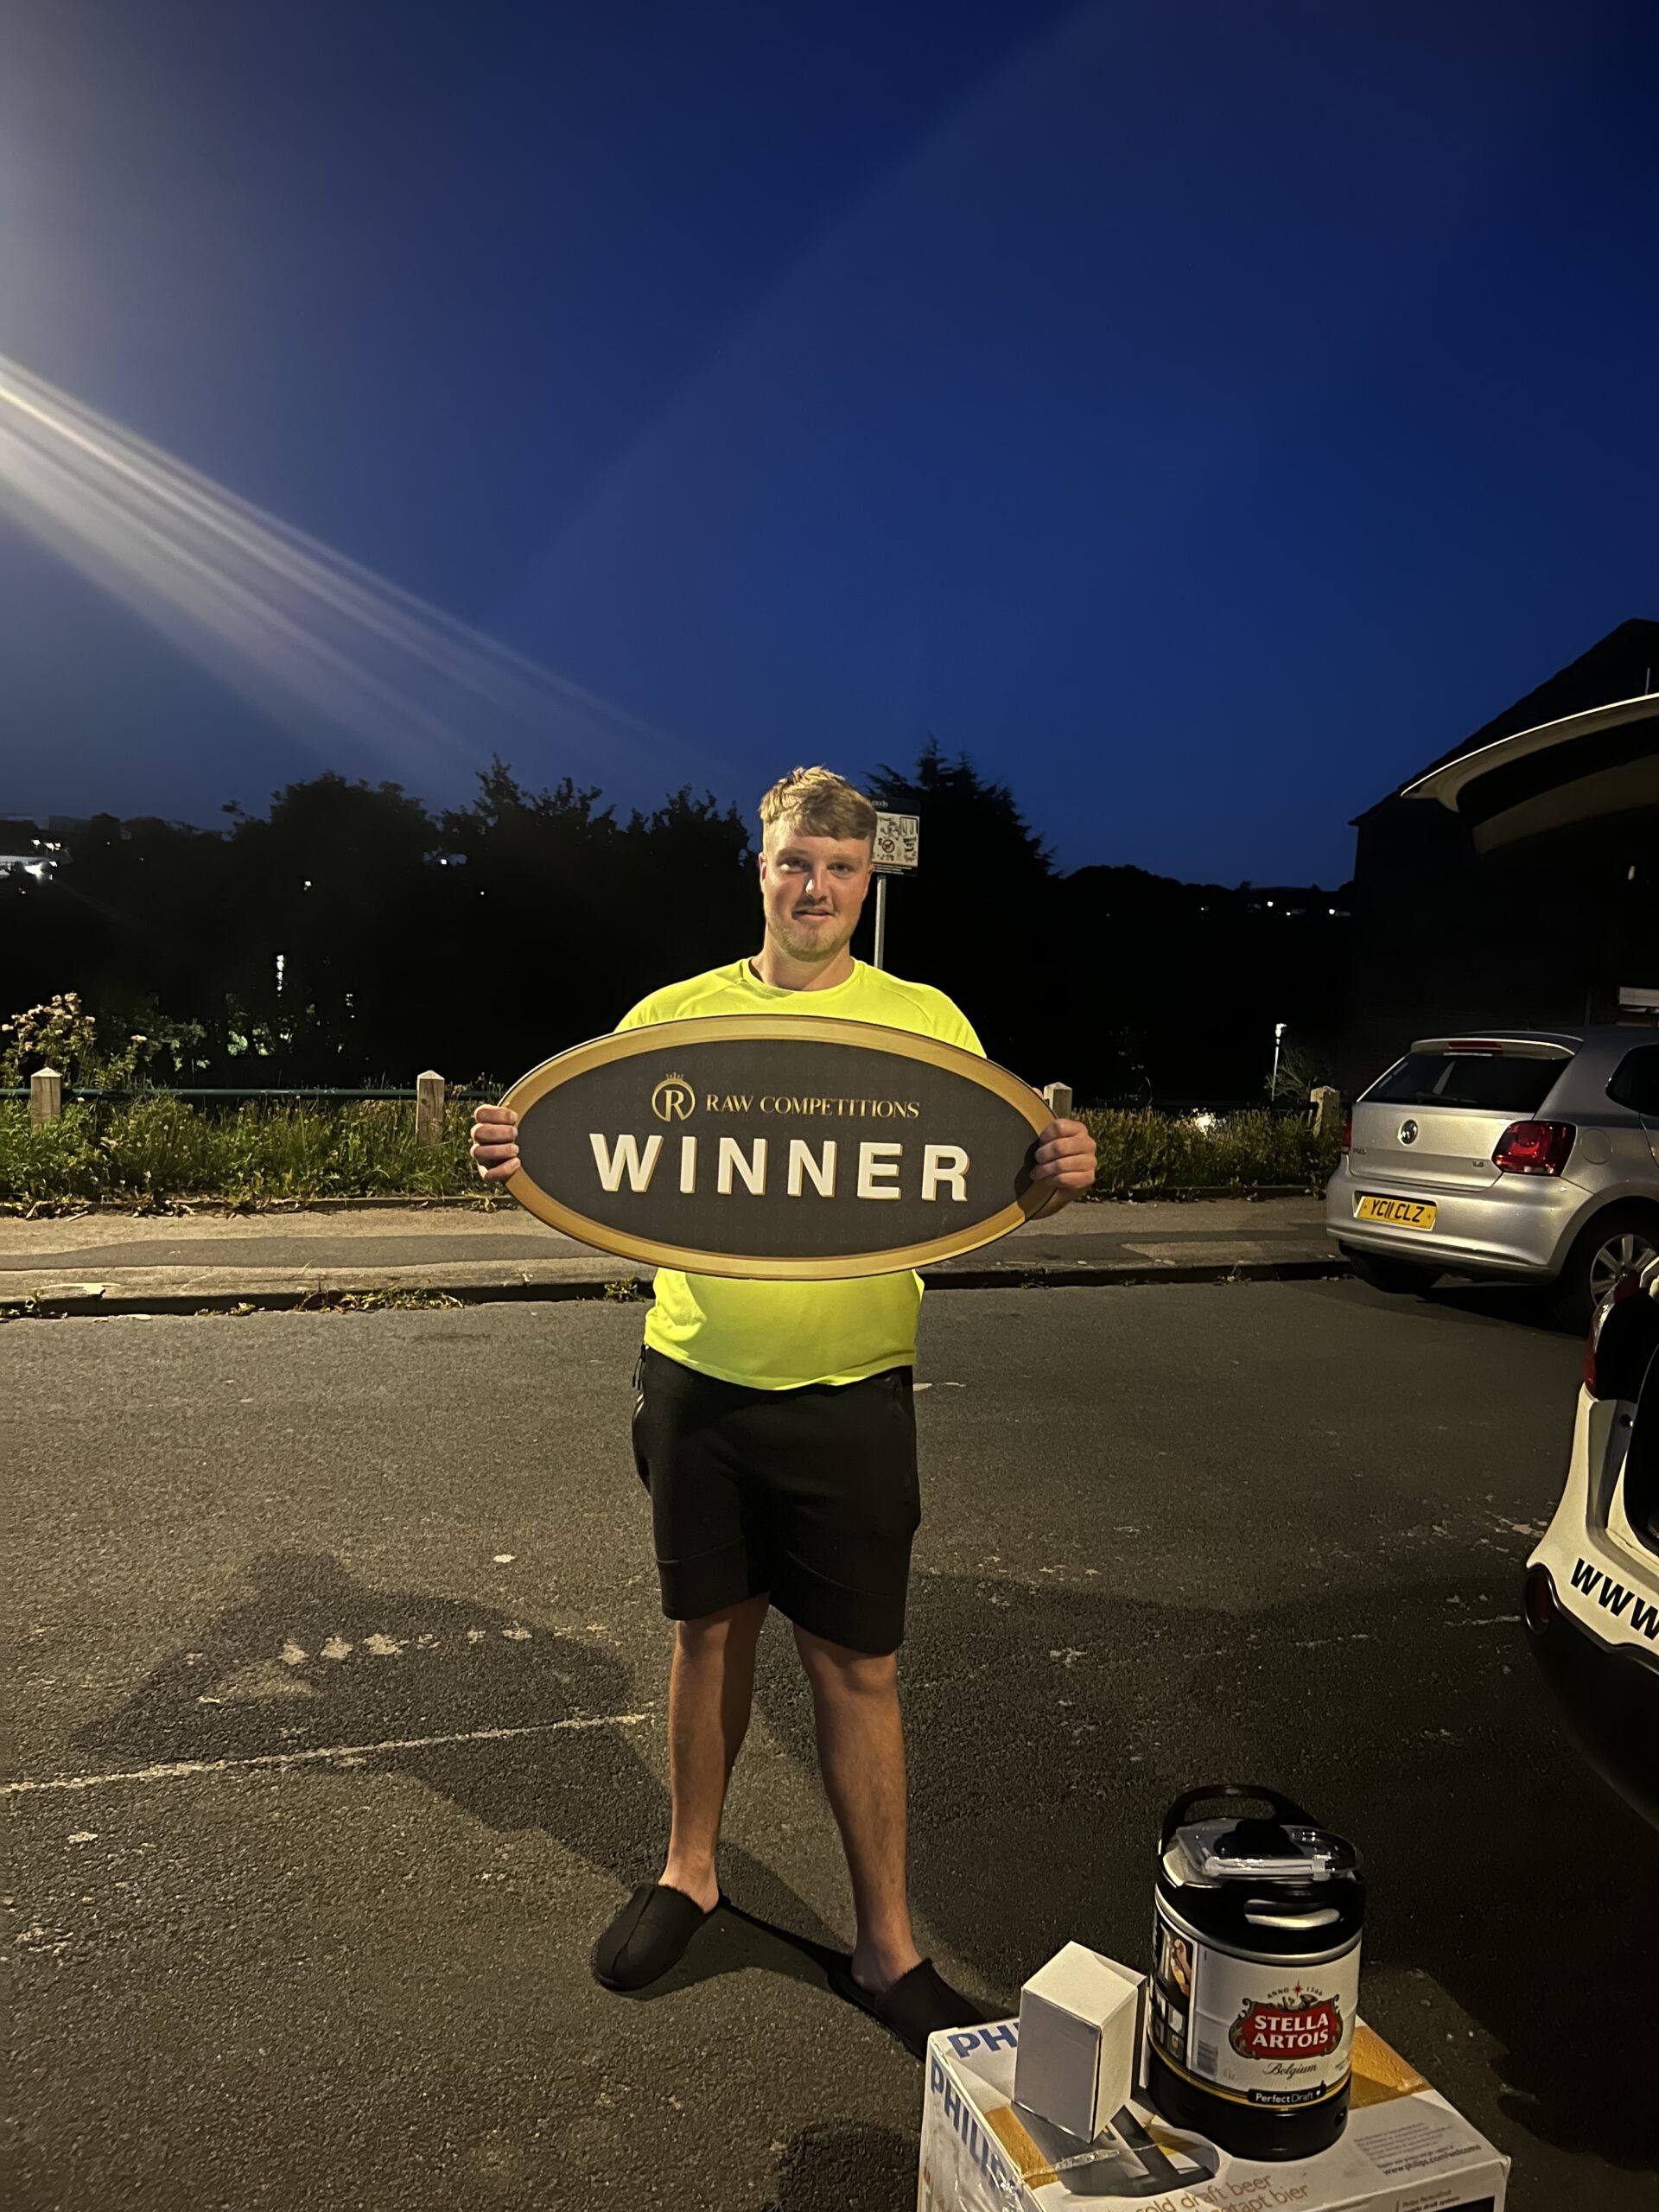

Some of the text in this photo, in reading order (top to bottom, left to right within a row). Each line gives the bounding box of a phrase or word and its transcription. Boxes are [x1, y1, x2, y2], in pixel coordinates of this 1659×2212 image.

[705, 1094, 920, 1119] RAW COMPETITIONS
[589, 1133, 970, 1202] WINNER
[1370, 1199, 1426, 1223] YC11 CLZ
[1267, 1987, 1289, 1999] ANNO
[1254, 2012, 1329, 2032] STELLA
[1252, 2029, 1329, 2049] ARTOIS
[1262, 2062, 1318, 2080] Belgium
[1255, 2091, 1313, 2104] PerfectDraft
[1180, 2184, 1229, 2209] draft
[1226, 2174, 1272, 2196] beer
[1268, 2185, 1308, 2204] bier
